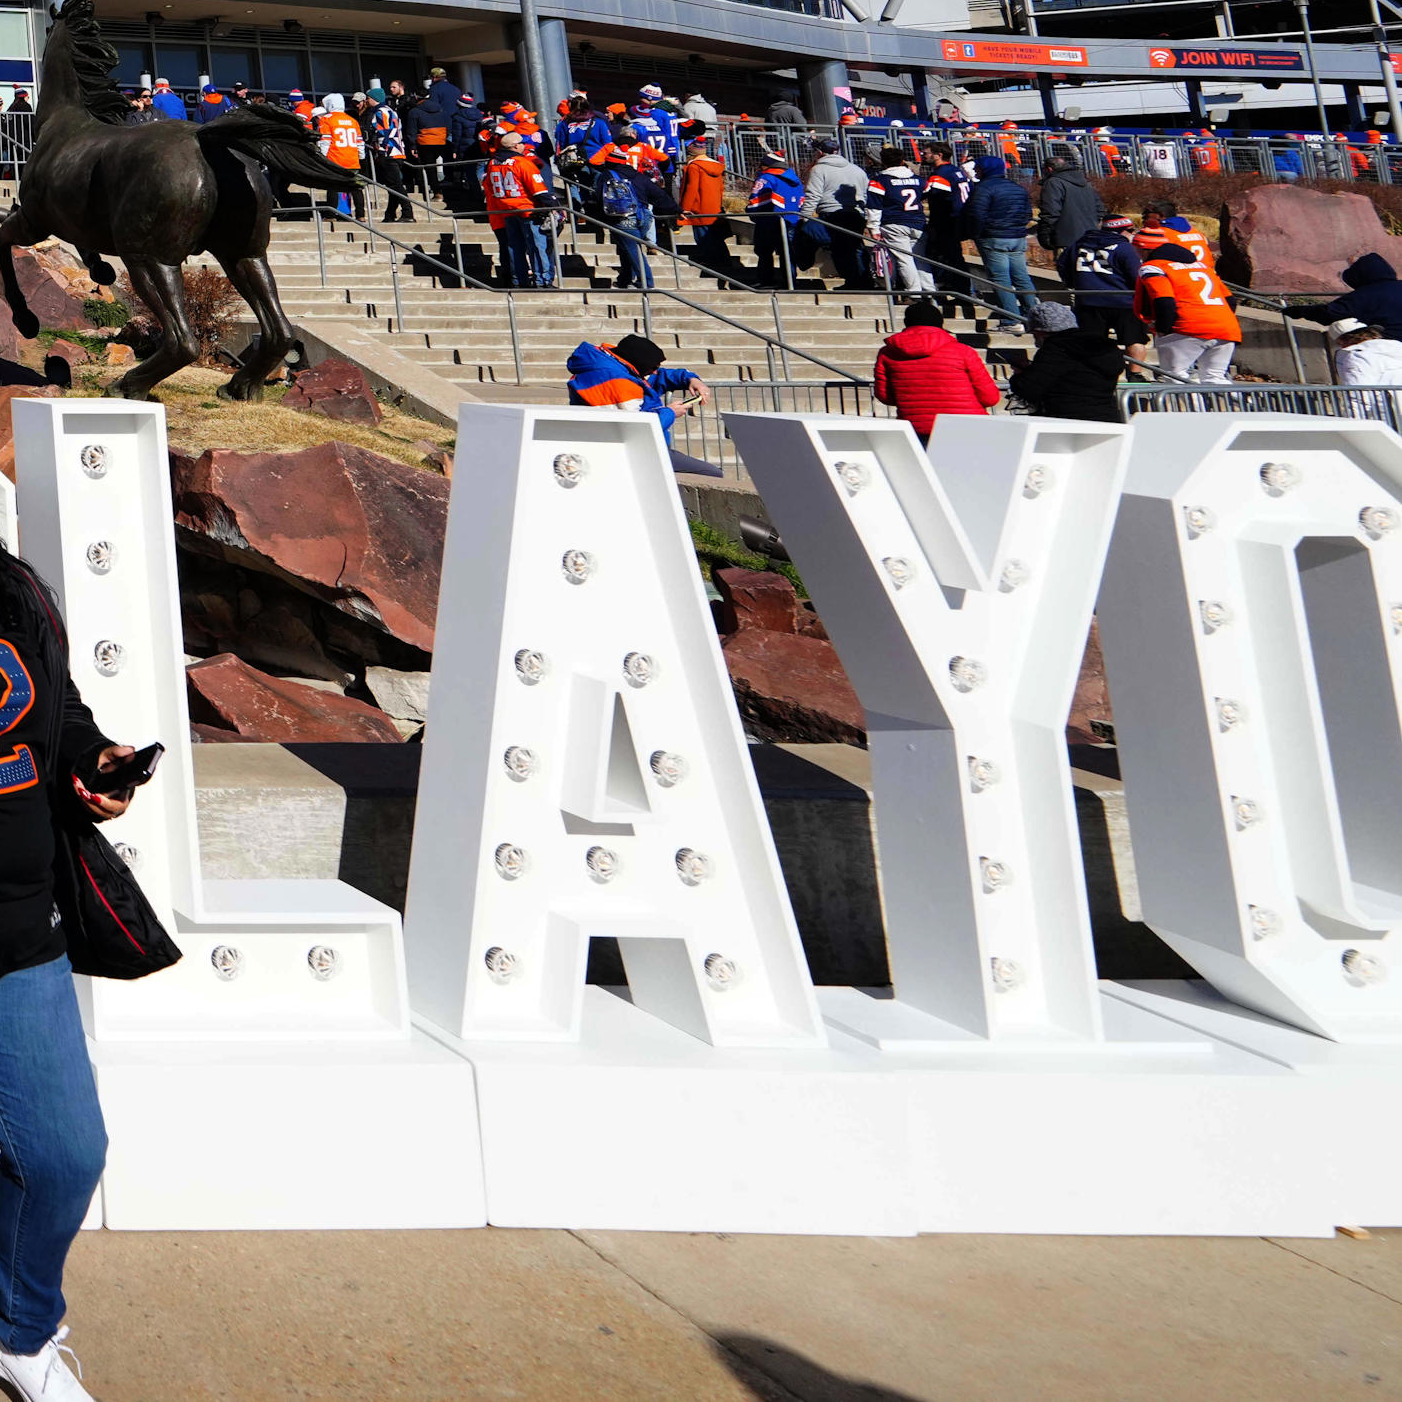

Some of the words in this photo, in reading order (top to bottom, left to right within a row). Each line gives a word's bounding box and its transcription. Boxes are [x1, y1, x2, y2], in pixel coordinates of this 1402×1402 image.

[1180, 51, 1218, 65] JOIN
[1220, 53, 1256, 66] WIFI
[334, 128, 358, 147] 30
[648, 135, 666, 153] 17
[1153, 149, 1167, 160] 18
[490, 171, 521, 198] 84
[901, 188, 920, 211] 2
[1189, 272, 1224, 305] 2
